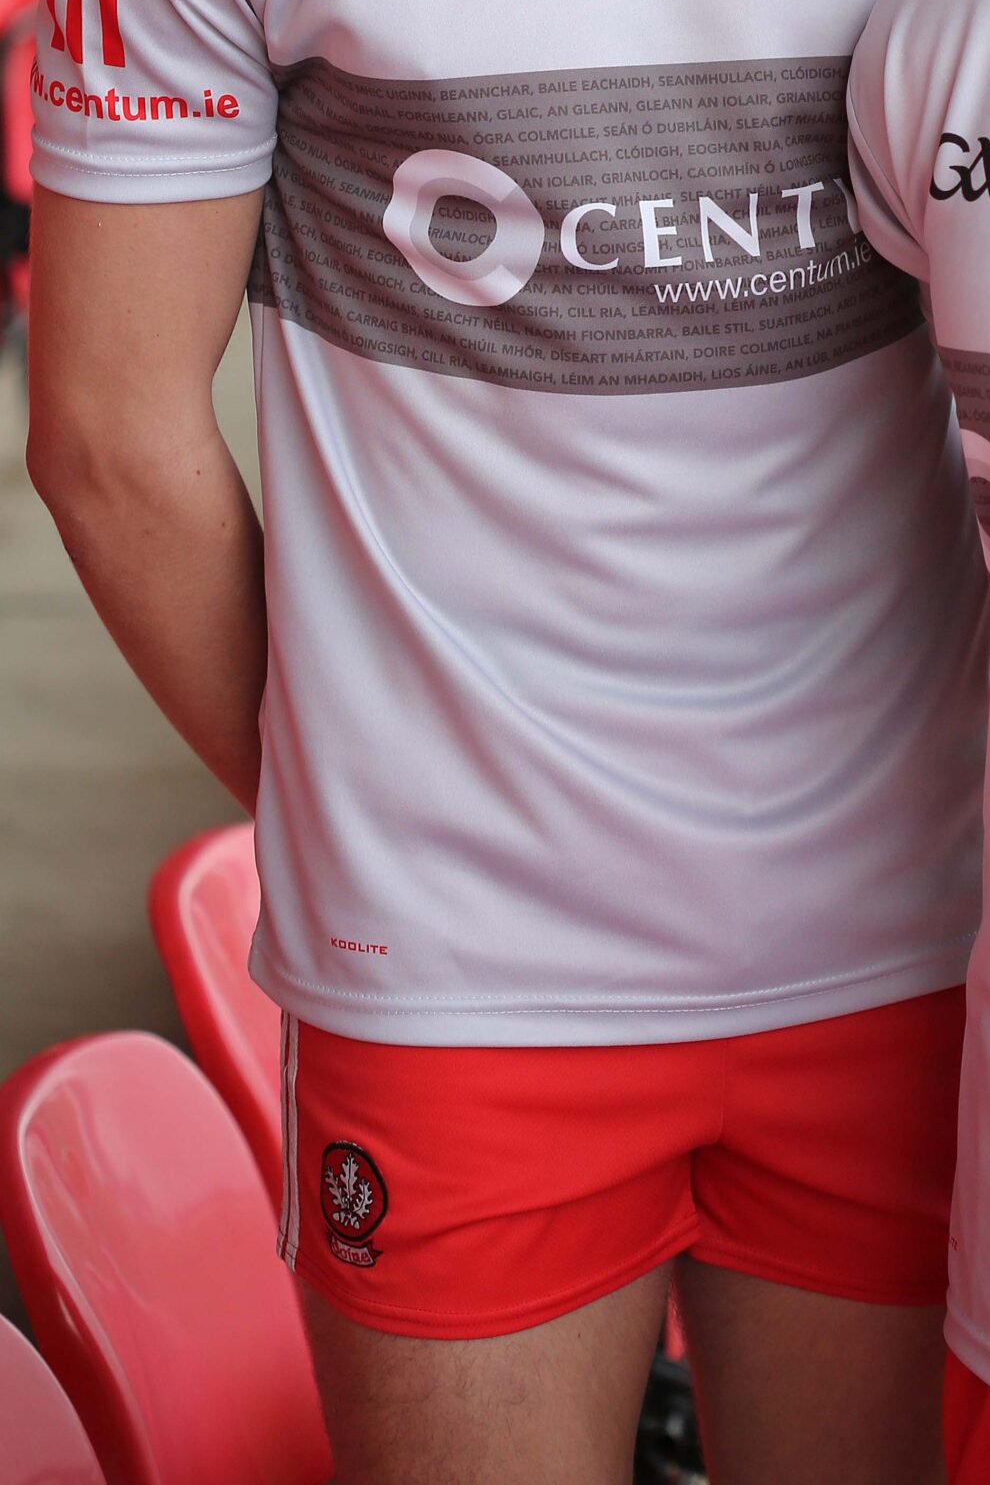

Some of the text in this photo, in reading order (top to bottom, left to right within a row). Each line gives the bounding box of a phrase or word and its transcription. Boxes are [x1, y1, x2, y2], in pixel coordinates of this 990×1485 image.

[387, 66, 845, 103] UIGINN, BEANNCHAR, BAILE EACHAIDH, SEANMHULLACH, CLÓIDIGH,
[396, 94, 772, 123] FORGHLEANN, GLAIC, AN GLEANN, GLEANN AN IOLAIR,
[438, 133, 468, 145] NUA,
[473, 132, 514, 145] ÓGRA
[518, 127, 599, 142] COLMCILLE,
[603, 122, 637, 137] SEÁN
[641, 121, 652, 134] Ó
[657, 117, 732, 134] DUBHLÁIN,
[736, 115, 793, 129] SLEACHT
[616, 139, 783, 160] CLÓIDIGH, EOGHAN RUA,
[547, 160, 775, 187] IOLAIR, GRIANLOCH, CAOIMHÍN Ó
[767, 248, 802, 261] BAILE
[654, 238, 873, 304] www.centum.ie
[552, 283, 573, 295] AN
[577, 282, 618, 295] CHÚIL
[318, 278, 366, 302] SLEACHT
[423, 308, 479, 326] SLEACHT
[483, 317, 521, 335] NÉILL,
[525, 326, 576, 341] NAOMH
[581, 327, 677, 342] FIONNBARRA,
[682, 324, 720, 337] BAILE
[724, 321, 754, 334] STIL,
[758, 305, 835, 330] SUAITREACH,
[568, 295, 778, 319] CILL RIA, AN
[347, 310, 397, 332] CARRAIG
[460, 337, 497, 354] CHÚIL
[502, 342, 546, 360] MHÓR,
[551, 349, 606, 364] DÍSEART
[611, 348, 689, 364] MHÁRTAIN,
[693, 345, 736, 359] DOIRE
[740, 334, 814, 356] COLMCILLE,
[422, 348, 782, 386] CILL LÉIM AN MHADAIDH, LIOS ÁINE,
[330, 937, 388, 956] KOOLITE
